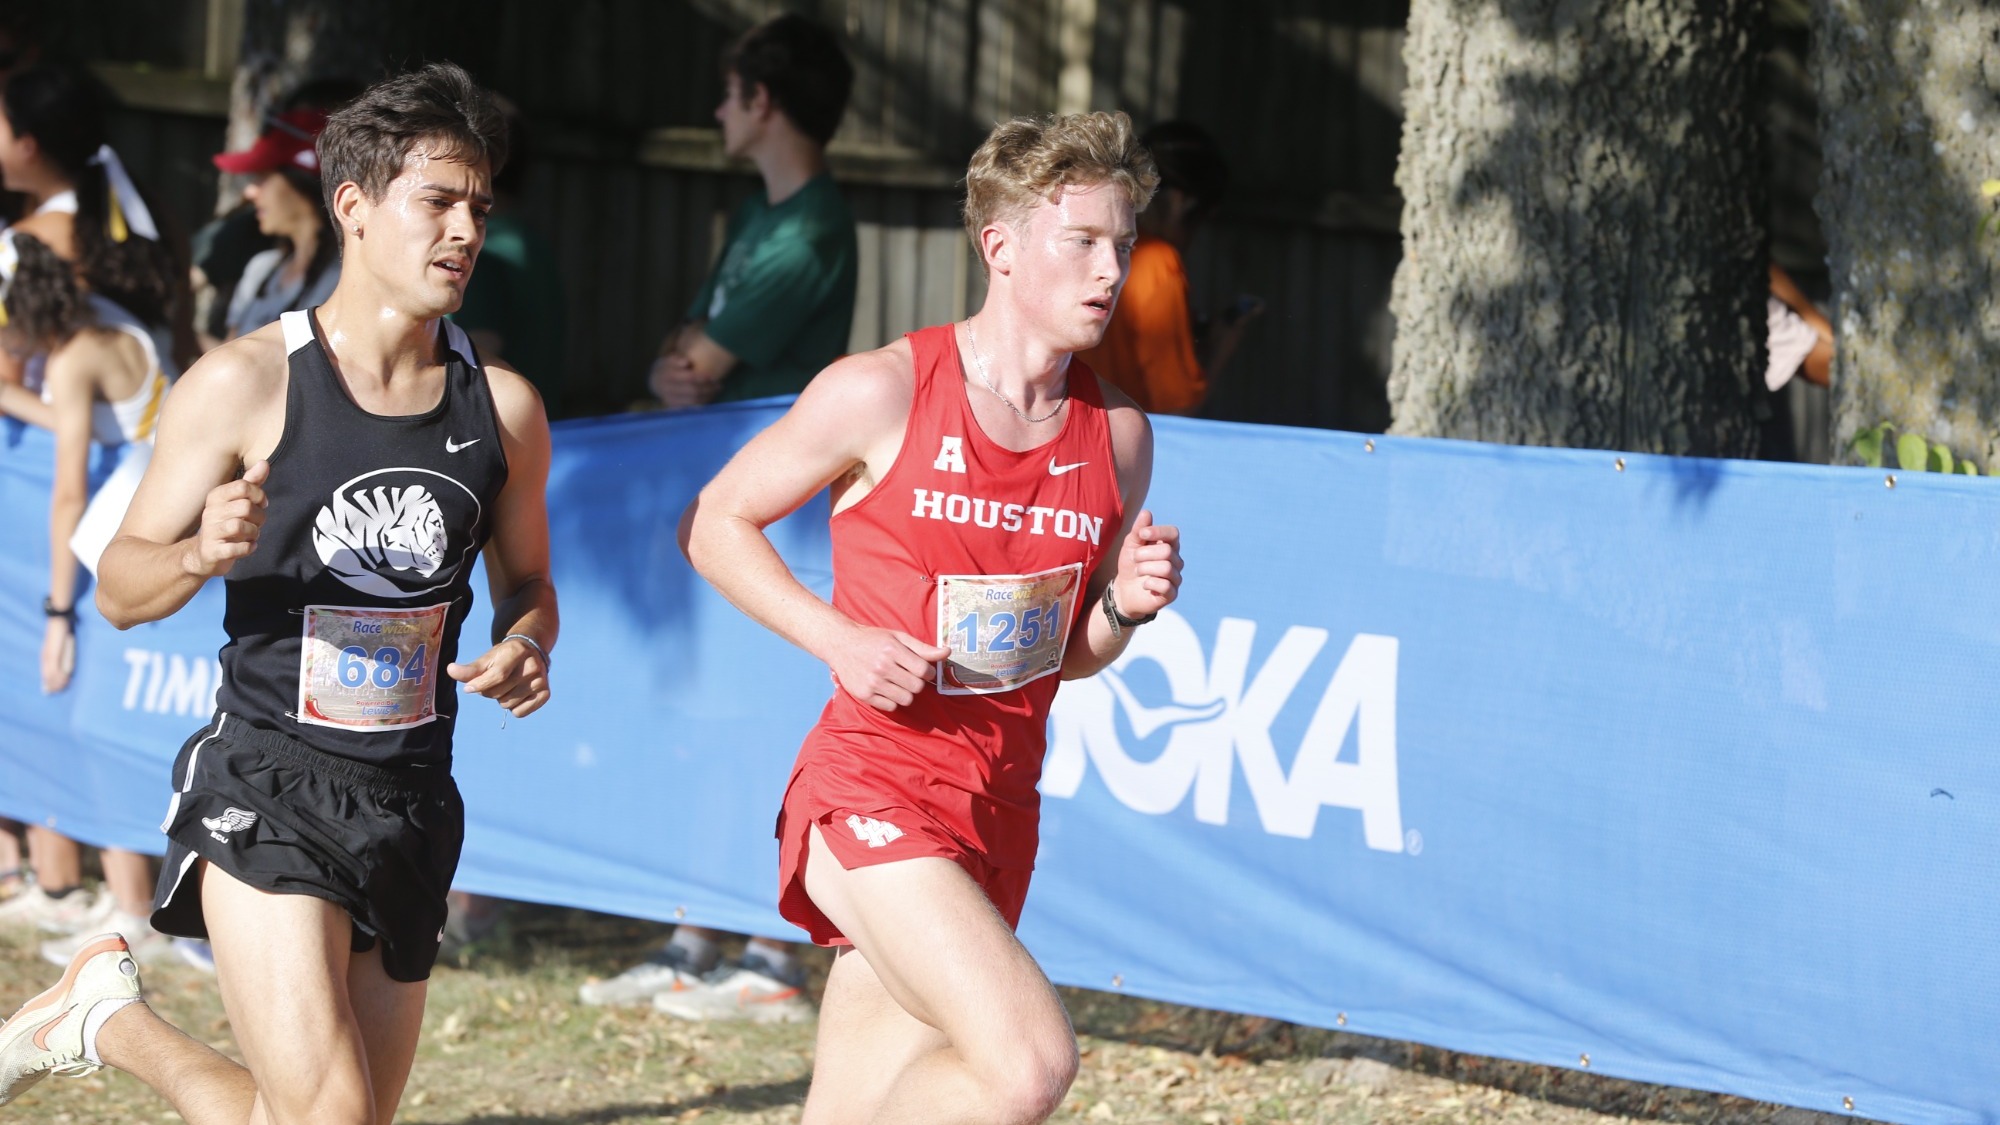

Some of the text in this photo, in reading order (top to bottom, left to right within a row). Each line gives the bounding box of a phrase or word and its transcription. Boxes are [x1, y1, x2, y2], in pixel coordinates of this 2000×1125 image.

[911, 488, 1103, 545] HOUSTON
[985, 588, 1046, 600] Racewiz
[956, 600, 1060, 654] 1251
[337, 643, 427, 690] 684
[362, 706, 390, 716] Lewis
